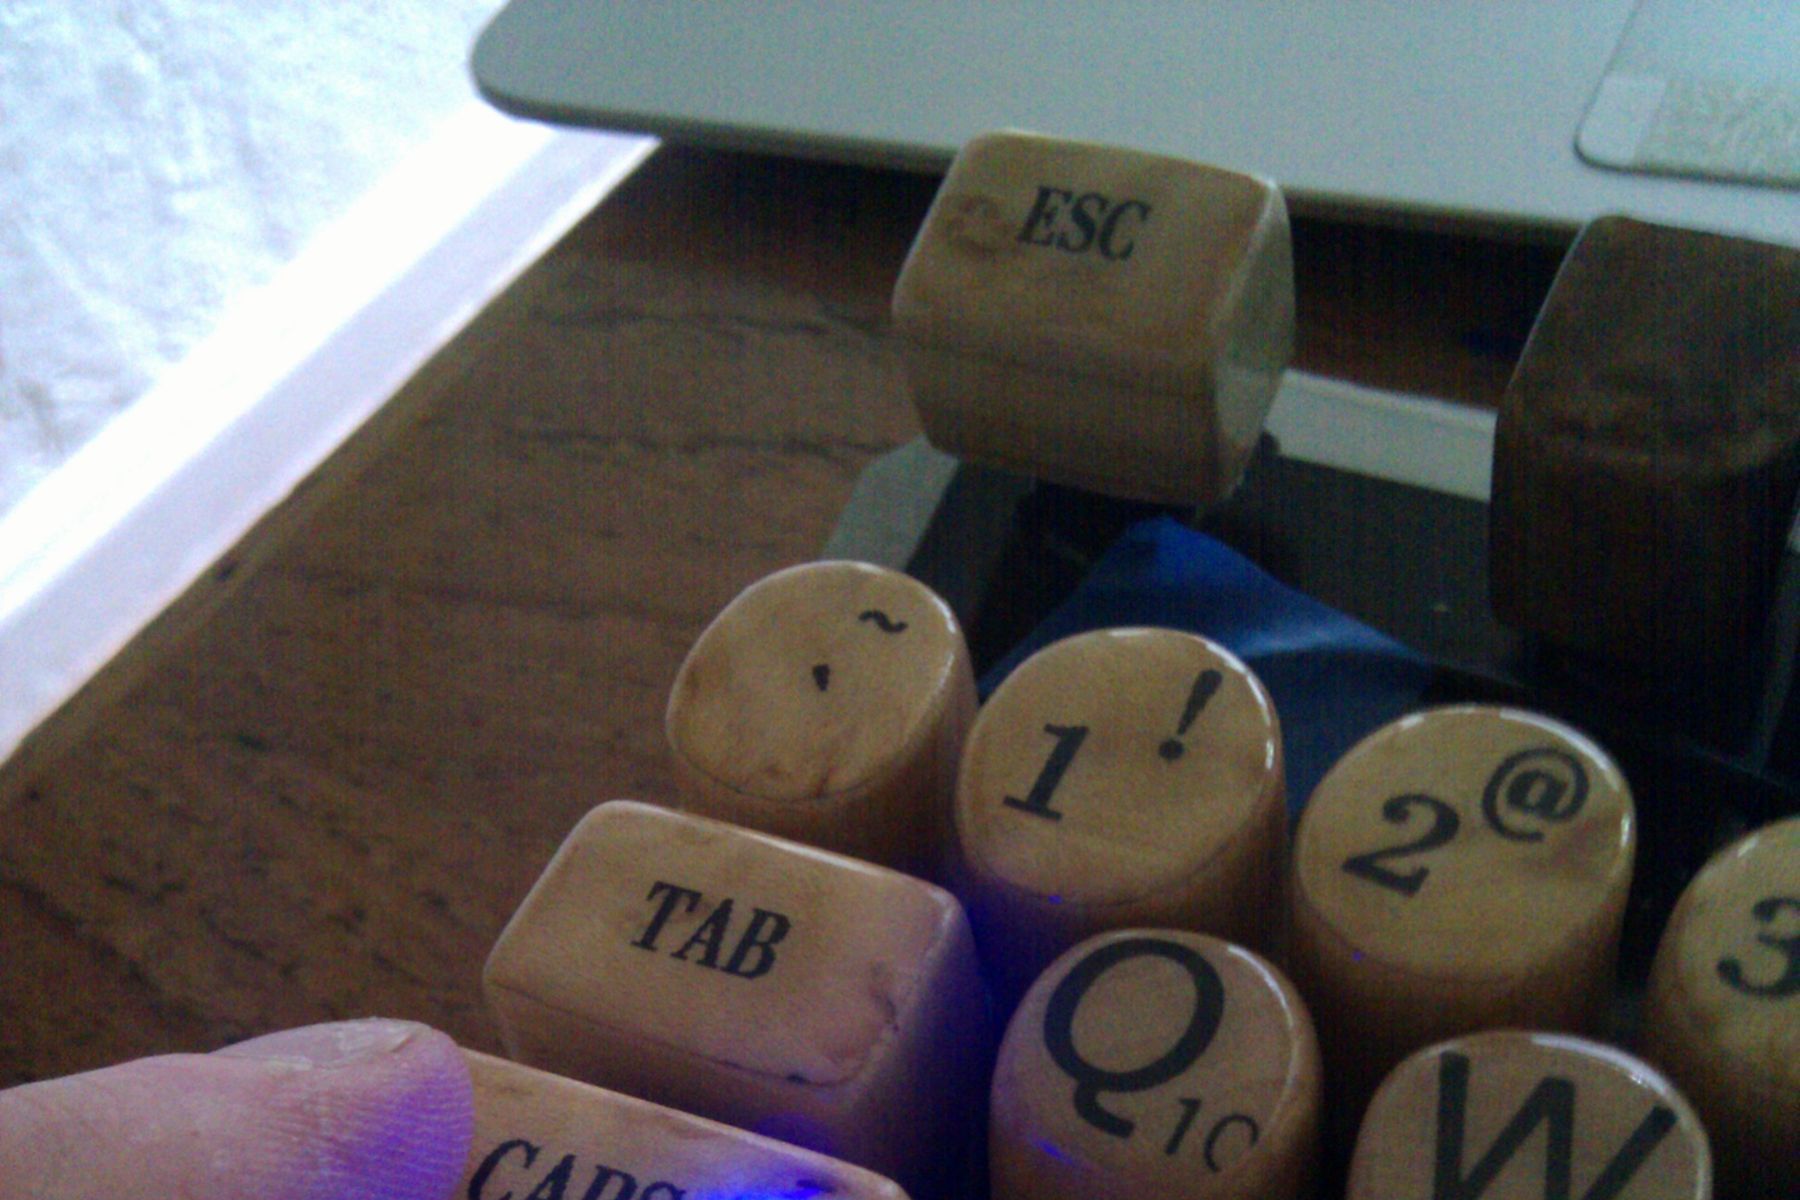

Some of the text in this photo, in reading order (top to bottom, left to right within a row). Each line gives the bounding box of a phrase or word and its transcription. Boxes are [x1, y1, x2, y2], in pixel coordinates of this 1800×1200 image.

[1016, 184, 1151, 263] ESC
[1003, 668, 1223, 821] 1 !
[1342, 746, 1590, 895] 2 @
[631, 880, 792, 981] TAB
[1717, 896, 1800, 997] 3
[1043, 936, 1227, 1139] Q
